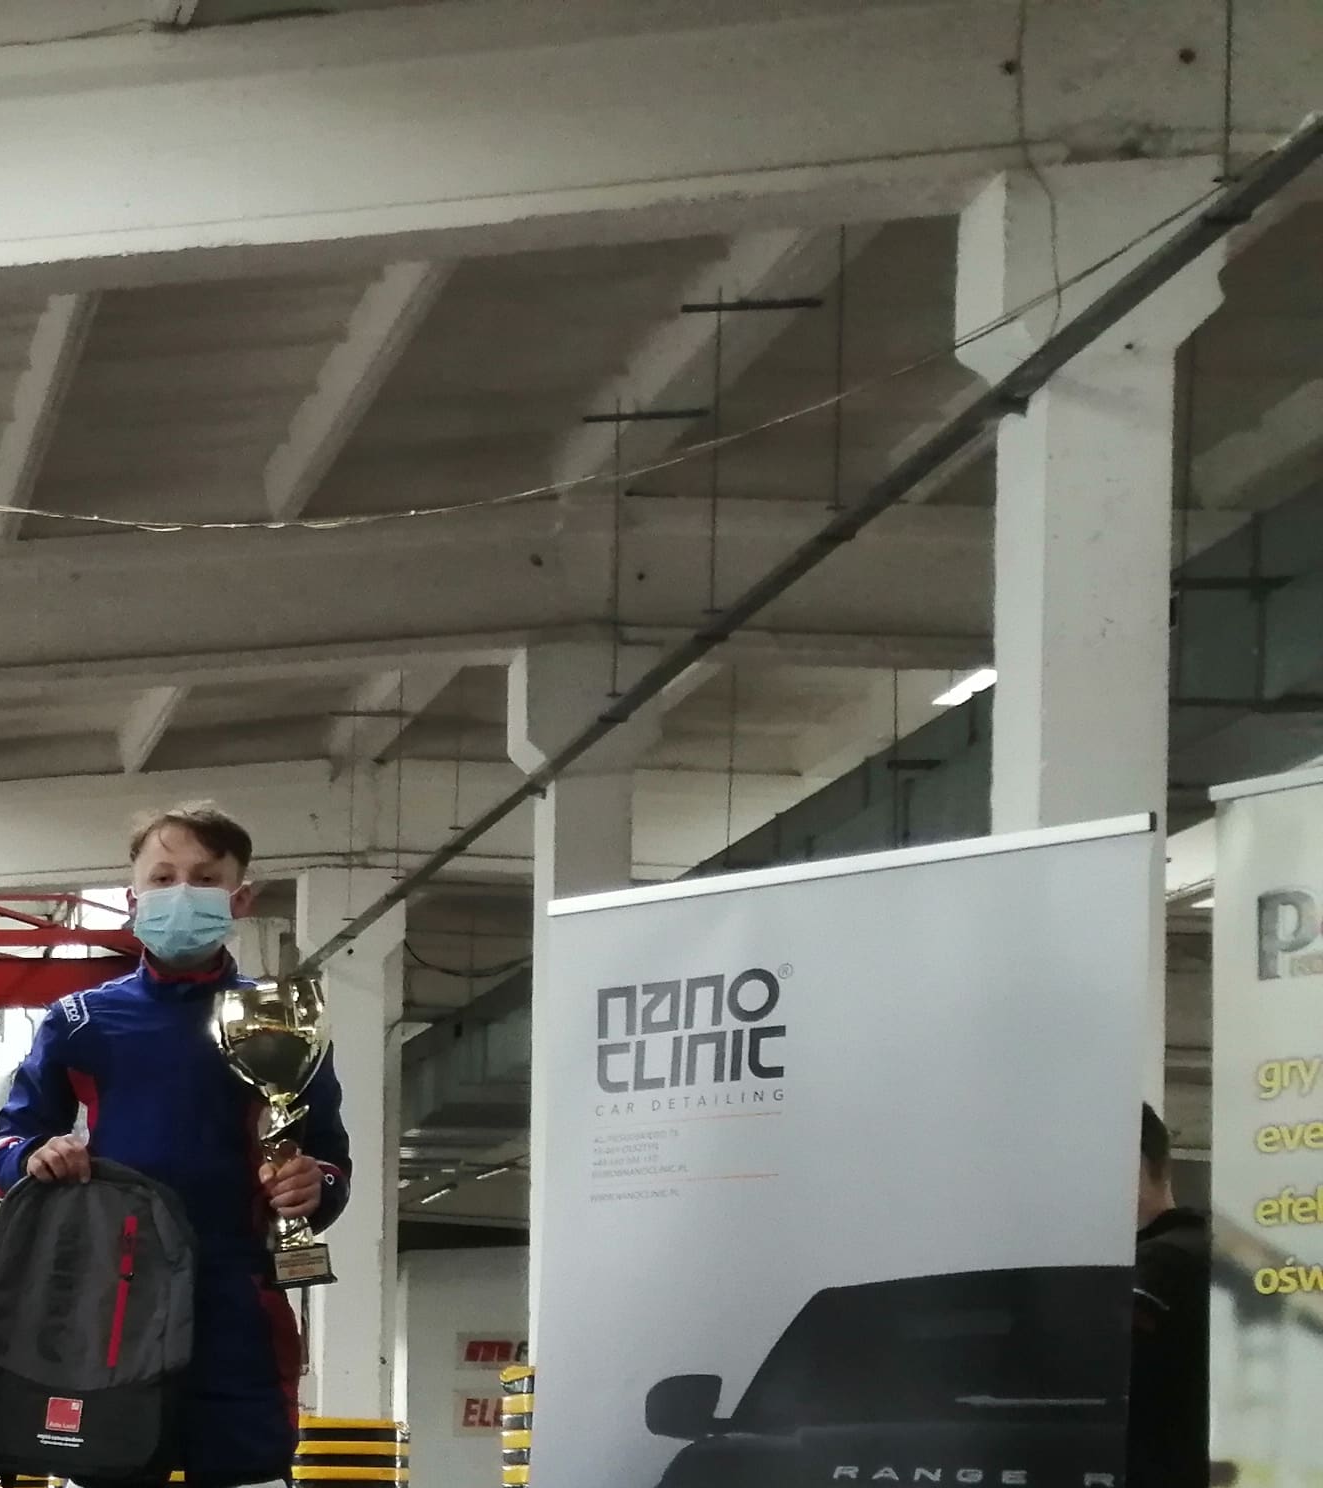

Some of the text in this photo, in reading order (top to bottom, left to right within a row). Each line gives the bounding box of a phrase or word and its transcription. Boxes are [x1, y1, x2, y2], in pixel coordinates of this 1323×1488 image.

[1258, 1058, 1322, 1100] gry
[594, 1088, 785, 1118] CAR DETAILING
[833, 1465, 1028, 1485] RANGE
